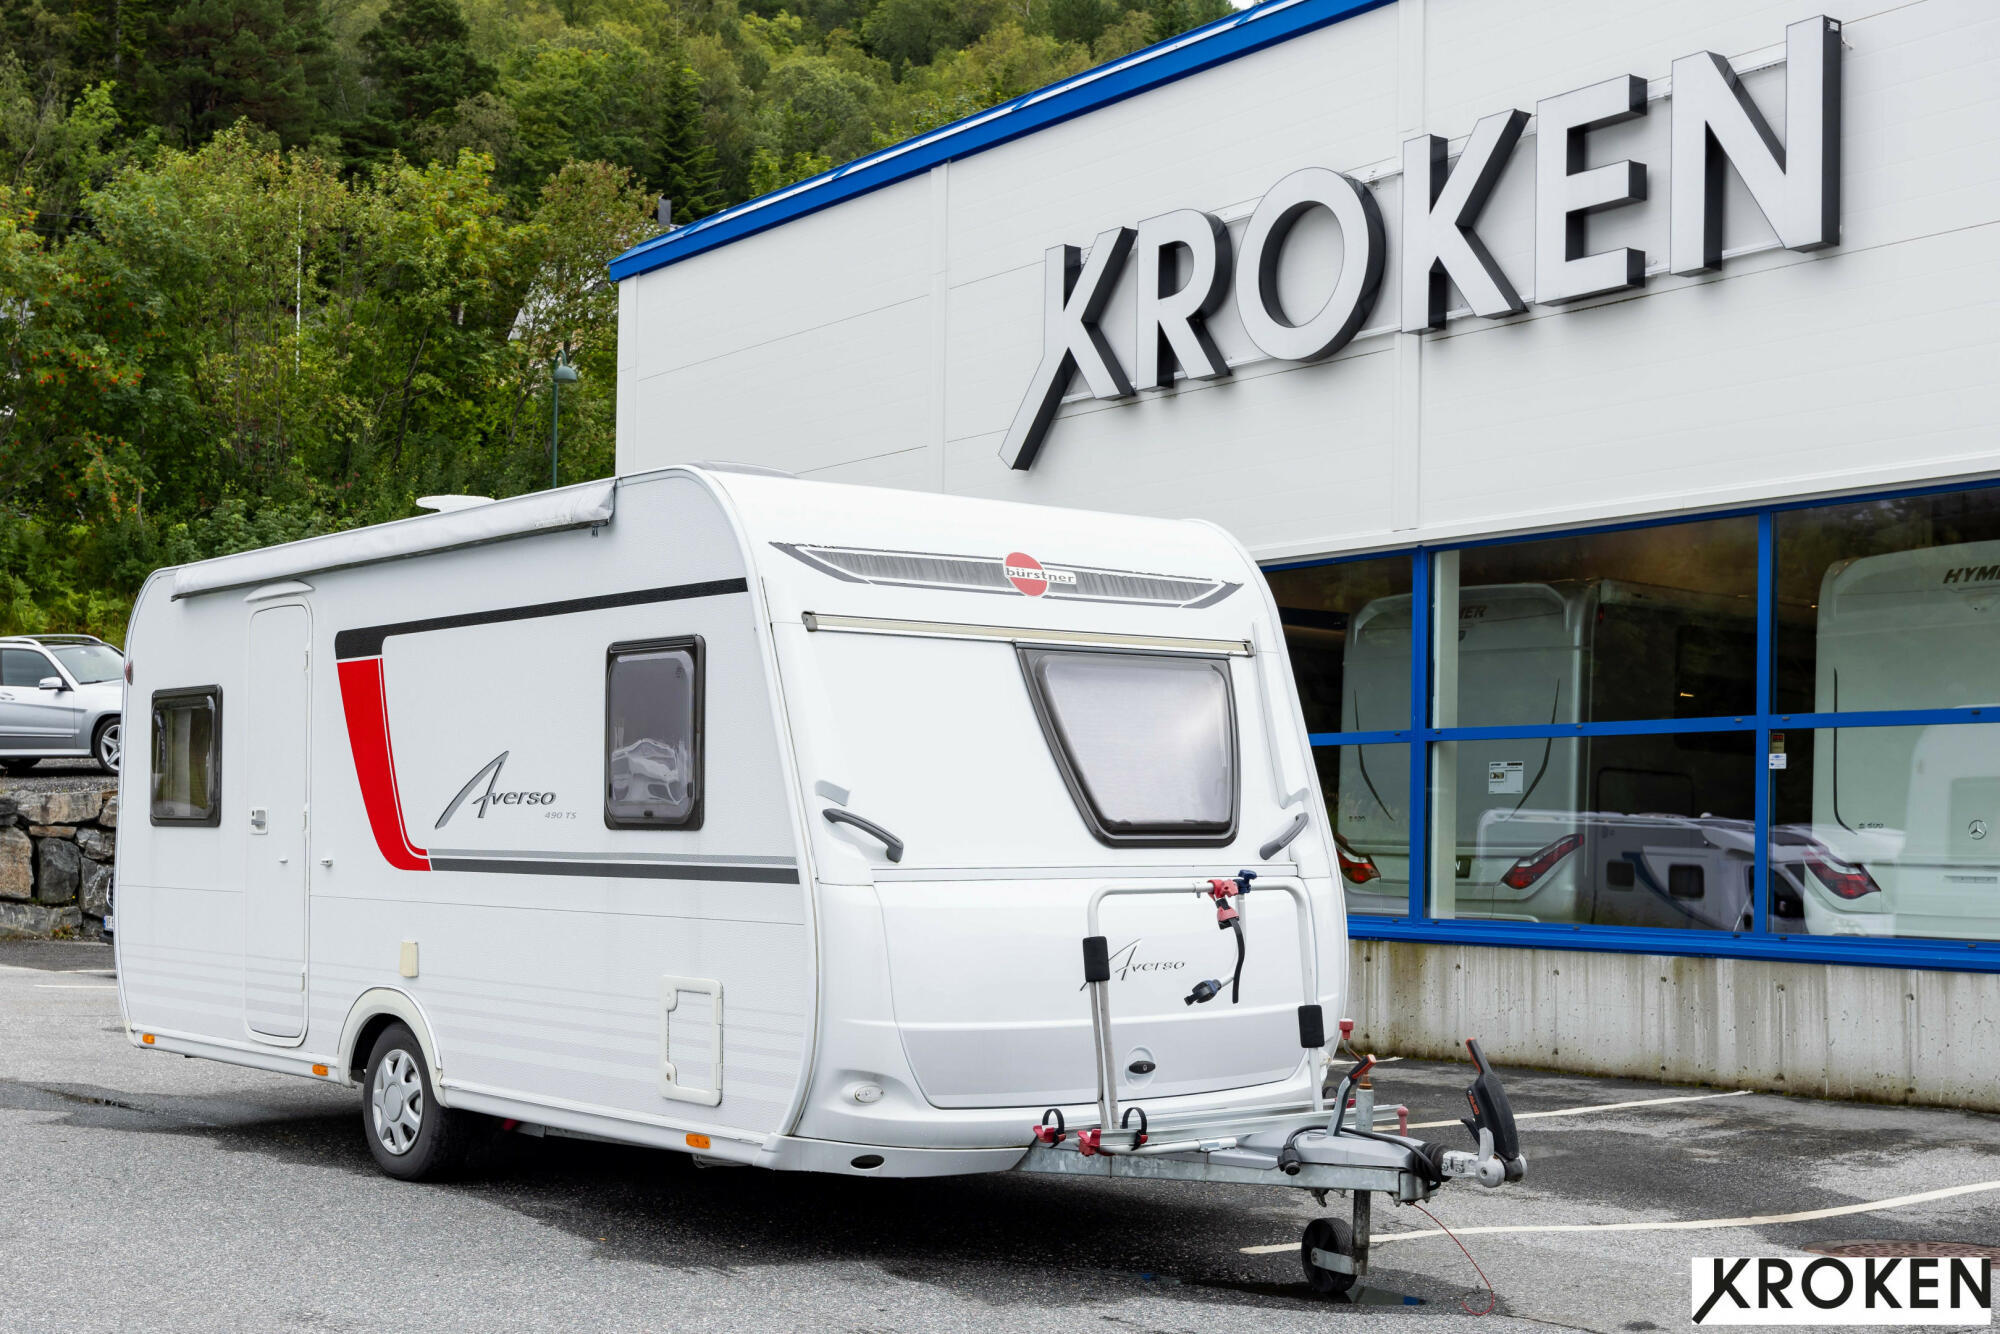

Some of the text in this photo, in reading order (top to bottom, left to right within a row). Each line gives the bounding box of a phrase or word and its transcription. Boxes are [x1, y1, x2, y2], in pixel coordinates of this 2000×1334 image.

[999, 15, 1840, 470] KROKEN
[1006, 567, 1075, 582] bürstner
[1942, 565, 2000, 584] HYM
[434, 750, 557, 829] Averso
[544, 811, 577, 820] 490 TS
[1080, 938, 1186, 991] Averso
